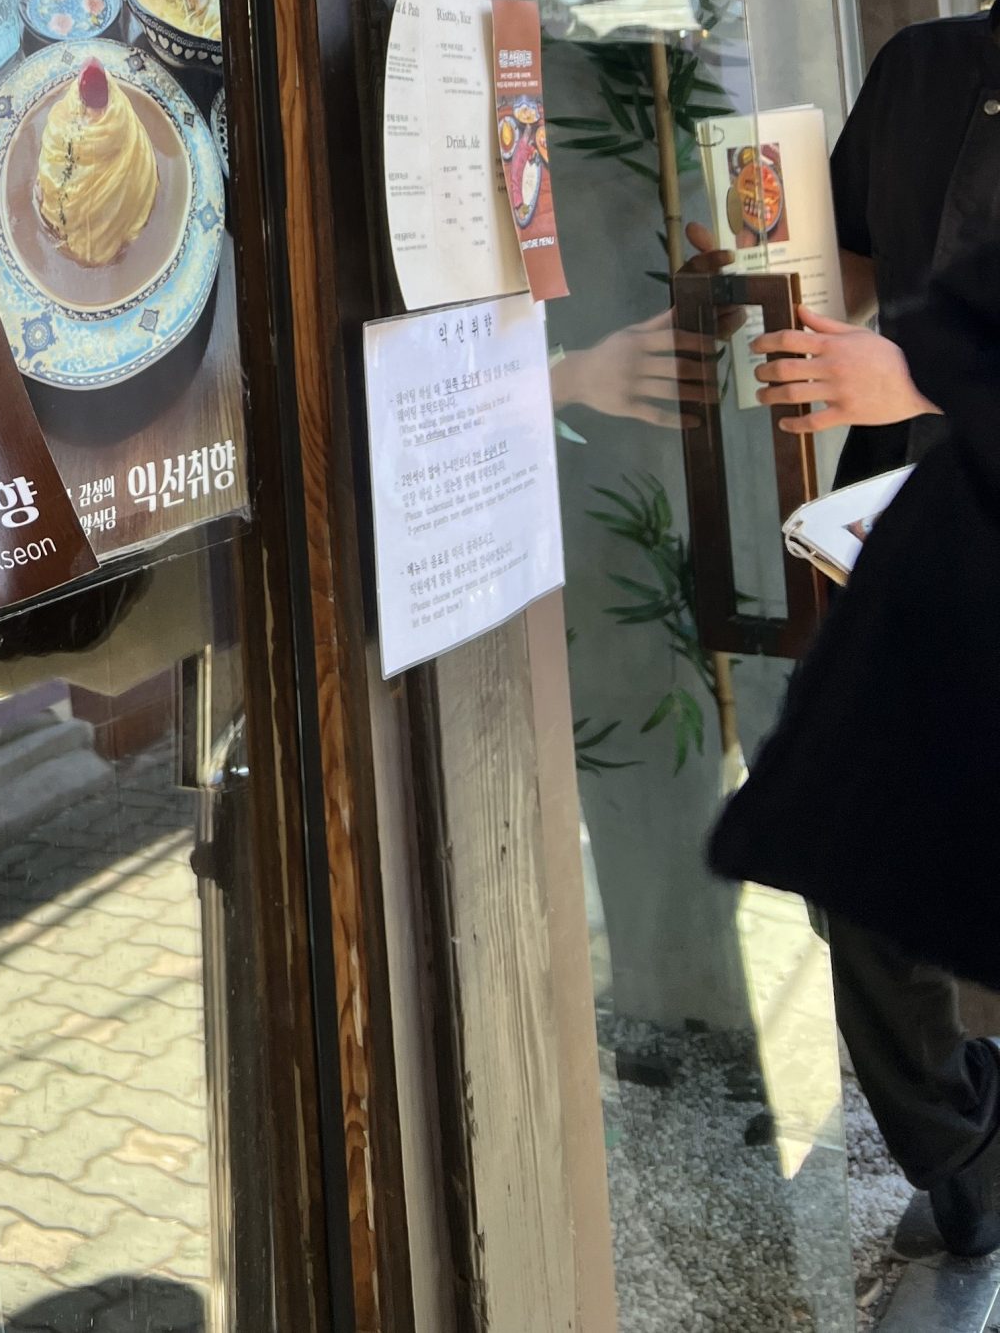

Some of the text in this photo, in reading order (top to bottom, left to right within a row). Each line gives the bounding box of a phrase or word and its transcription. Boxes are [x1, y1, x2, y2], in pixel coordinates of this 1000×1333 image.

[79, 440, 237, 513] 감성의 익선취향
[79, 506, 117, 537] 양식당
